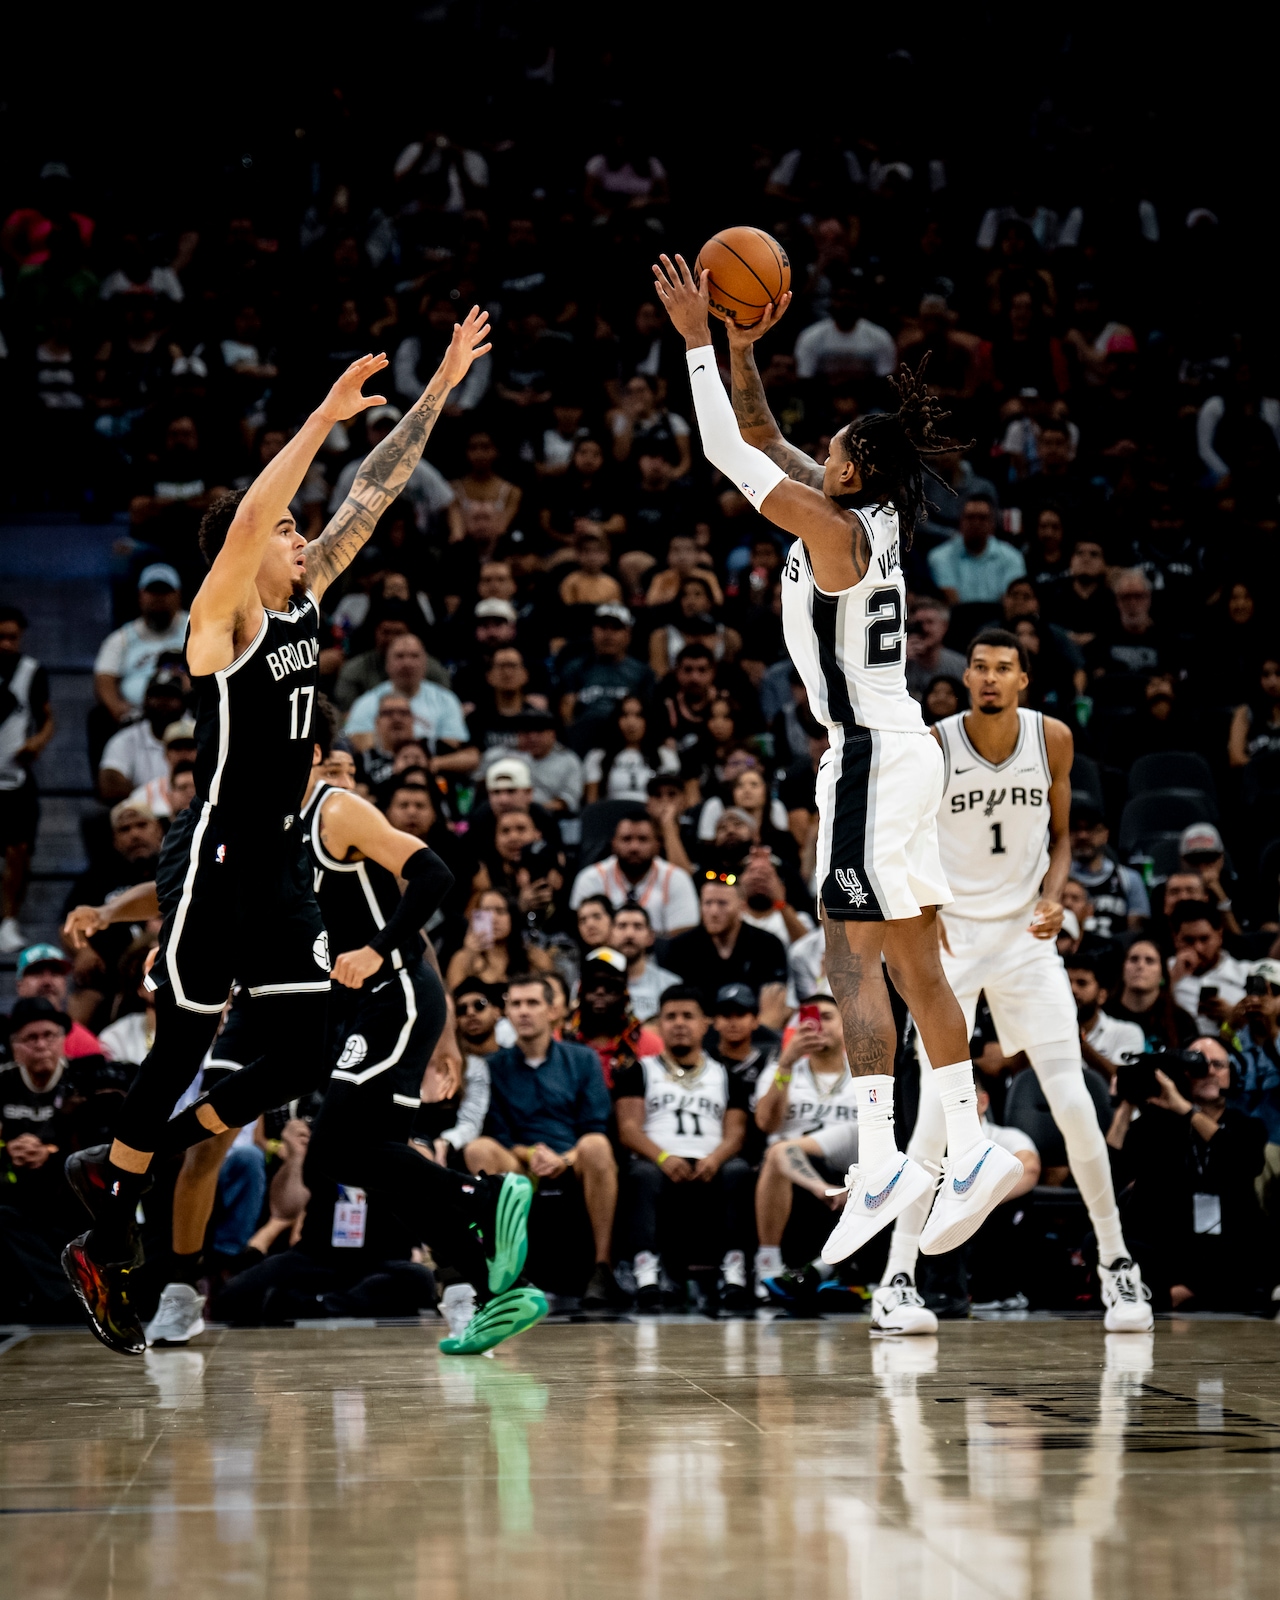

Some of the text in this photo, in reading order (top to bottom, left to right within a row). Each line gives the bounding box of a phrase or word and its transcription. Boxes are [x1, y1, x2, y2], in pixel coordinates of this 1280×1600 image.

[288, 685, 315, 740] 17
[951, 787, 1043, 817] SPURS
[991, 822, 1006, 855] 1
[675, 1109, 703, 1136] 11
